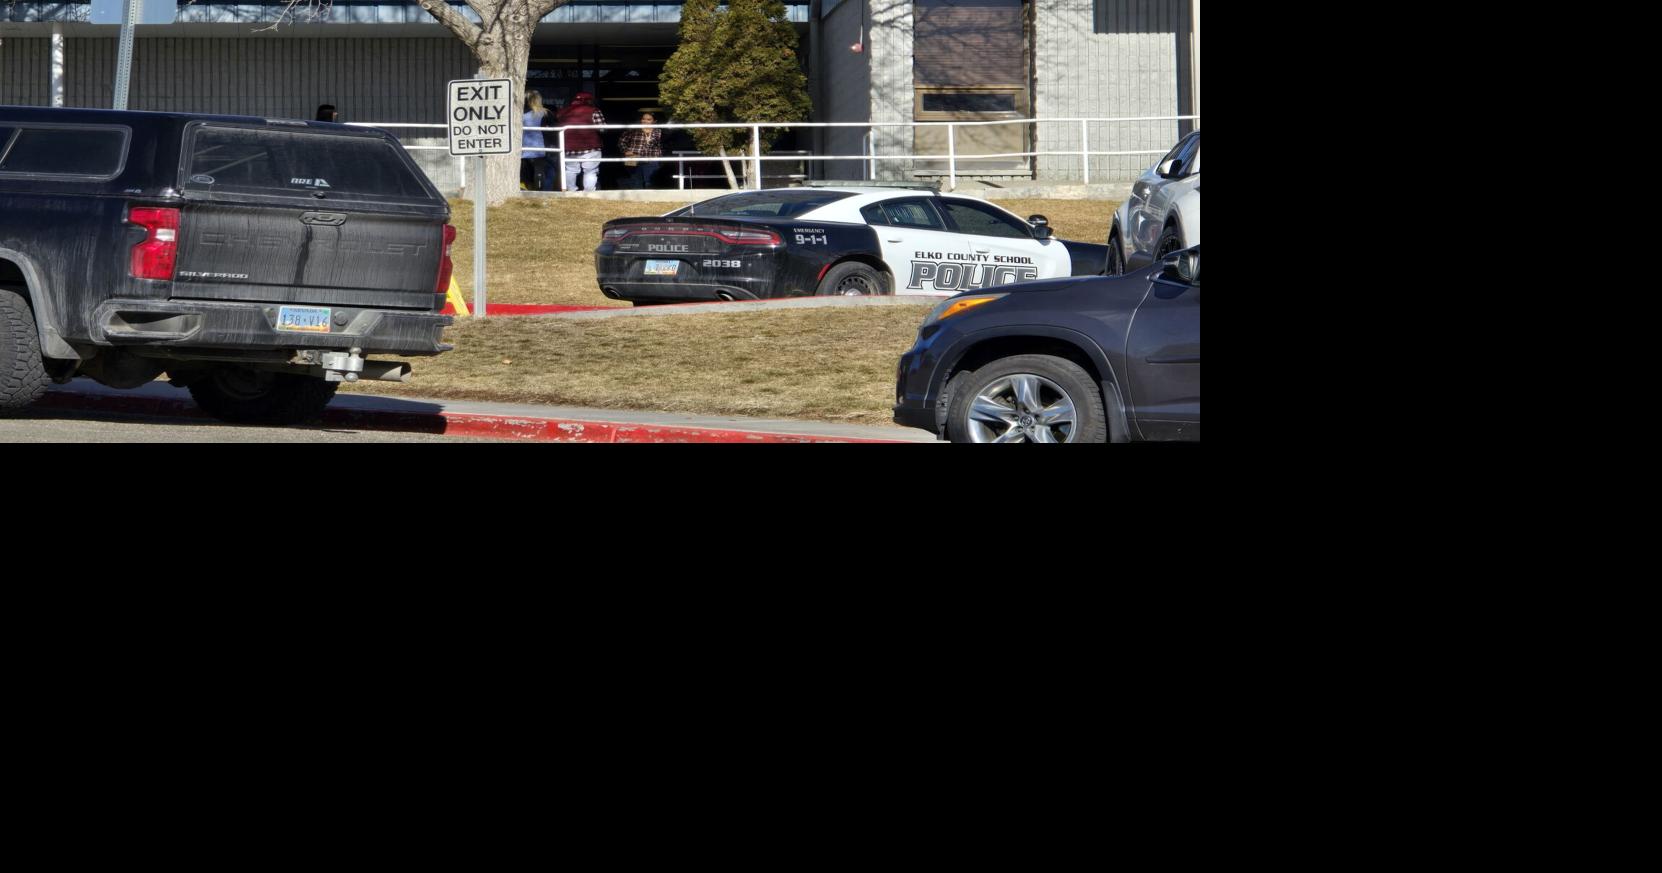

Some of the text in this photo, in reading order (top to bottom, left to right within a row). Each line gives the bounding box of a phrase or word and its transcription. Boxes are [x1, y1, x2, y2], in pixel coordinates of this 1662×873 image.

[457, 85, 502, 101] EXIT
[453, 105, 506, 121] ONLY
[453, 124, 507, 136] DO NOT
[458, 138, 502, 149] ENTER
[198, 231, 428, 256] CHEVROLET
[795, 234, 828, 245] 9-1-1
[648, 243, 689, 253] POLICE
[702, 259, 741, 268] 2038
[914, 251, 1035, 264] ELKO COUNTY SCHOOL
[179, 271, 249, 279] SILVERADO
[906, 260, 1038, 292] POLICE
